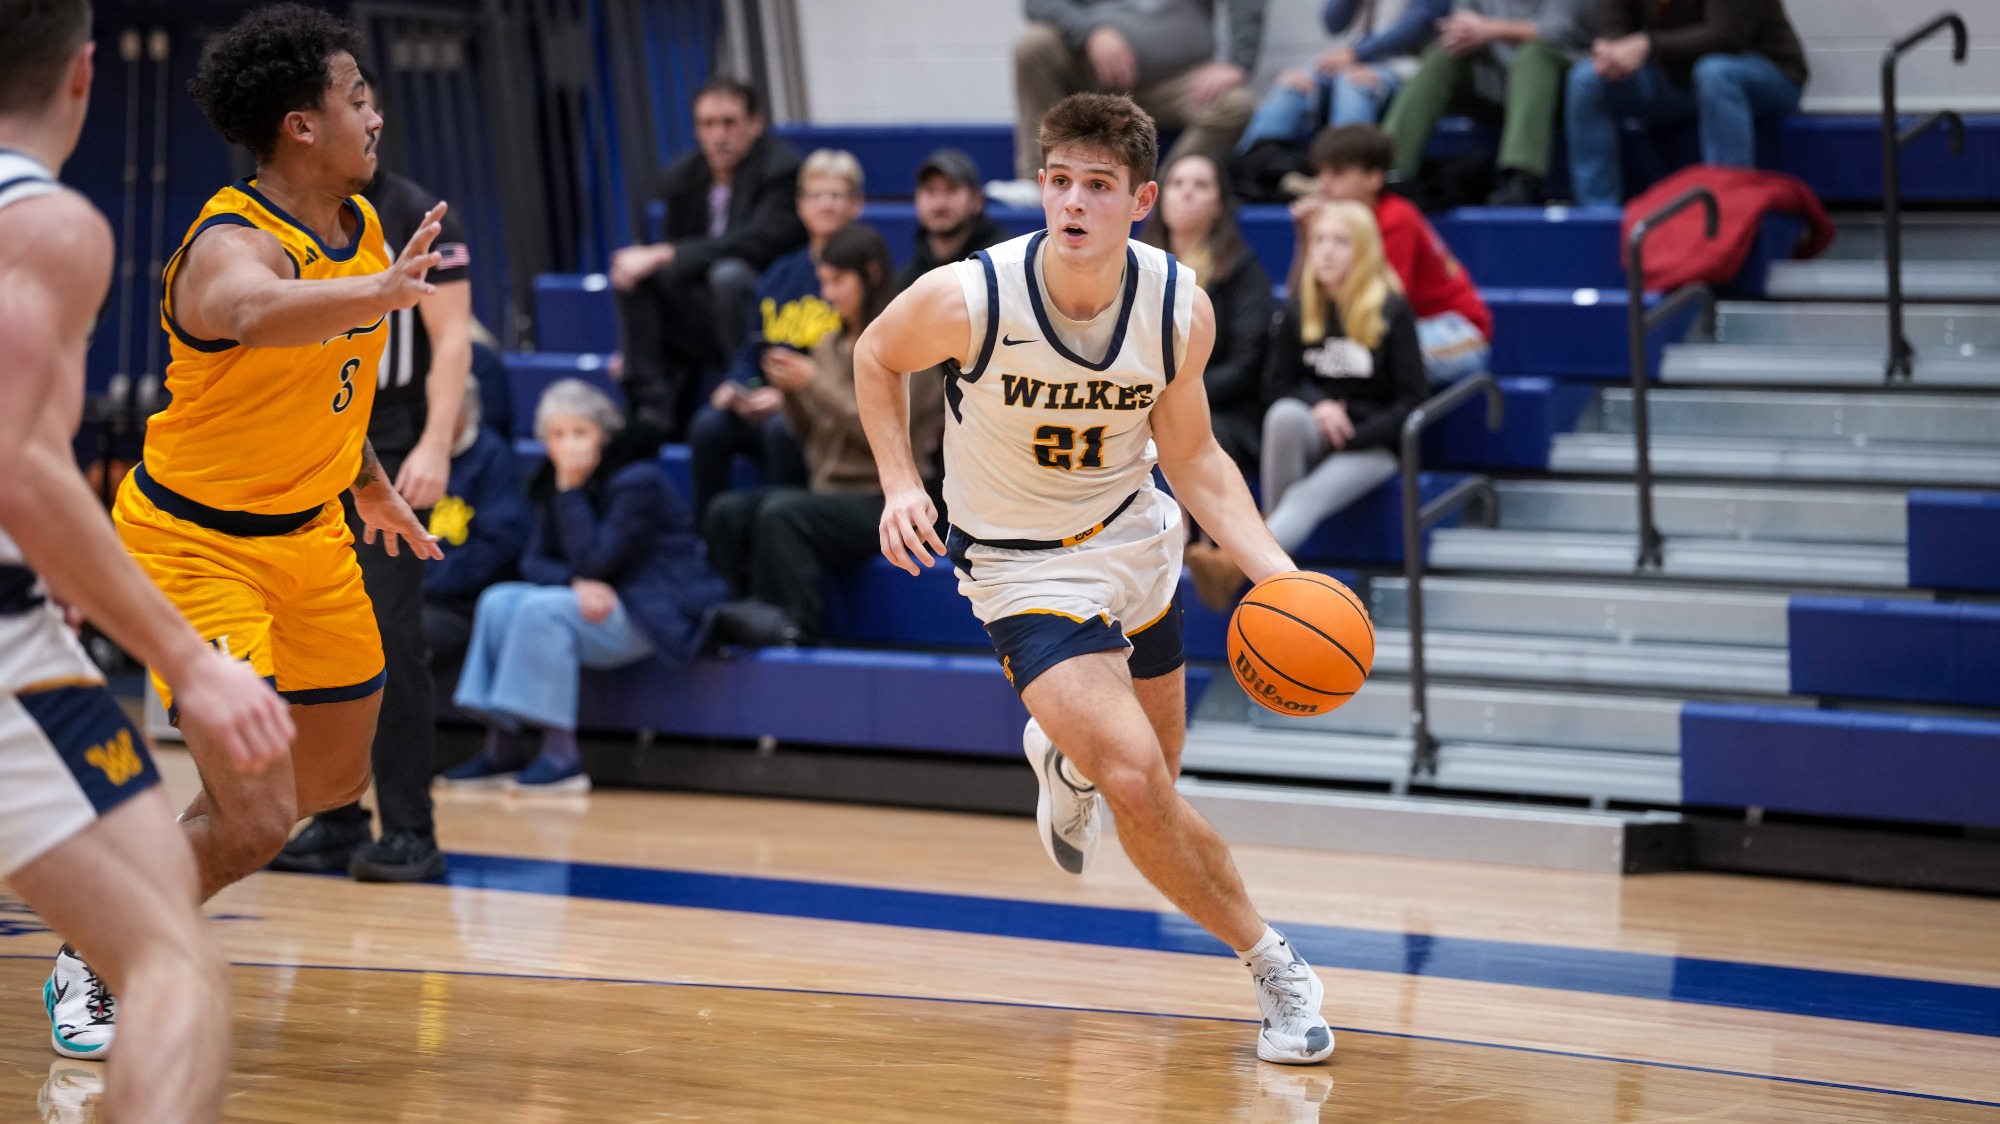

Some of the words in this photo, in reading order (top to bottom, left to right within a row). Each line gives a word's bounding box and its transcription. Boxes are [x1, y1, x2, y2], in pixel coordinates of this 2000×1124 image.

[331, 357, 361, 414] 3
[1001, 374, 1154, 411] WILKES
[1032, 425, 1109, 472] 21
[1235, 650, 1318, 713] Wilson
